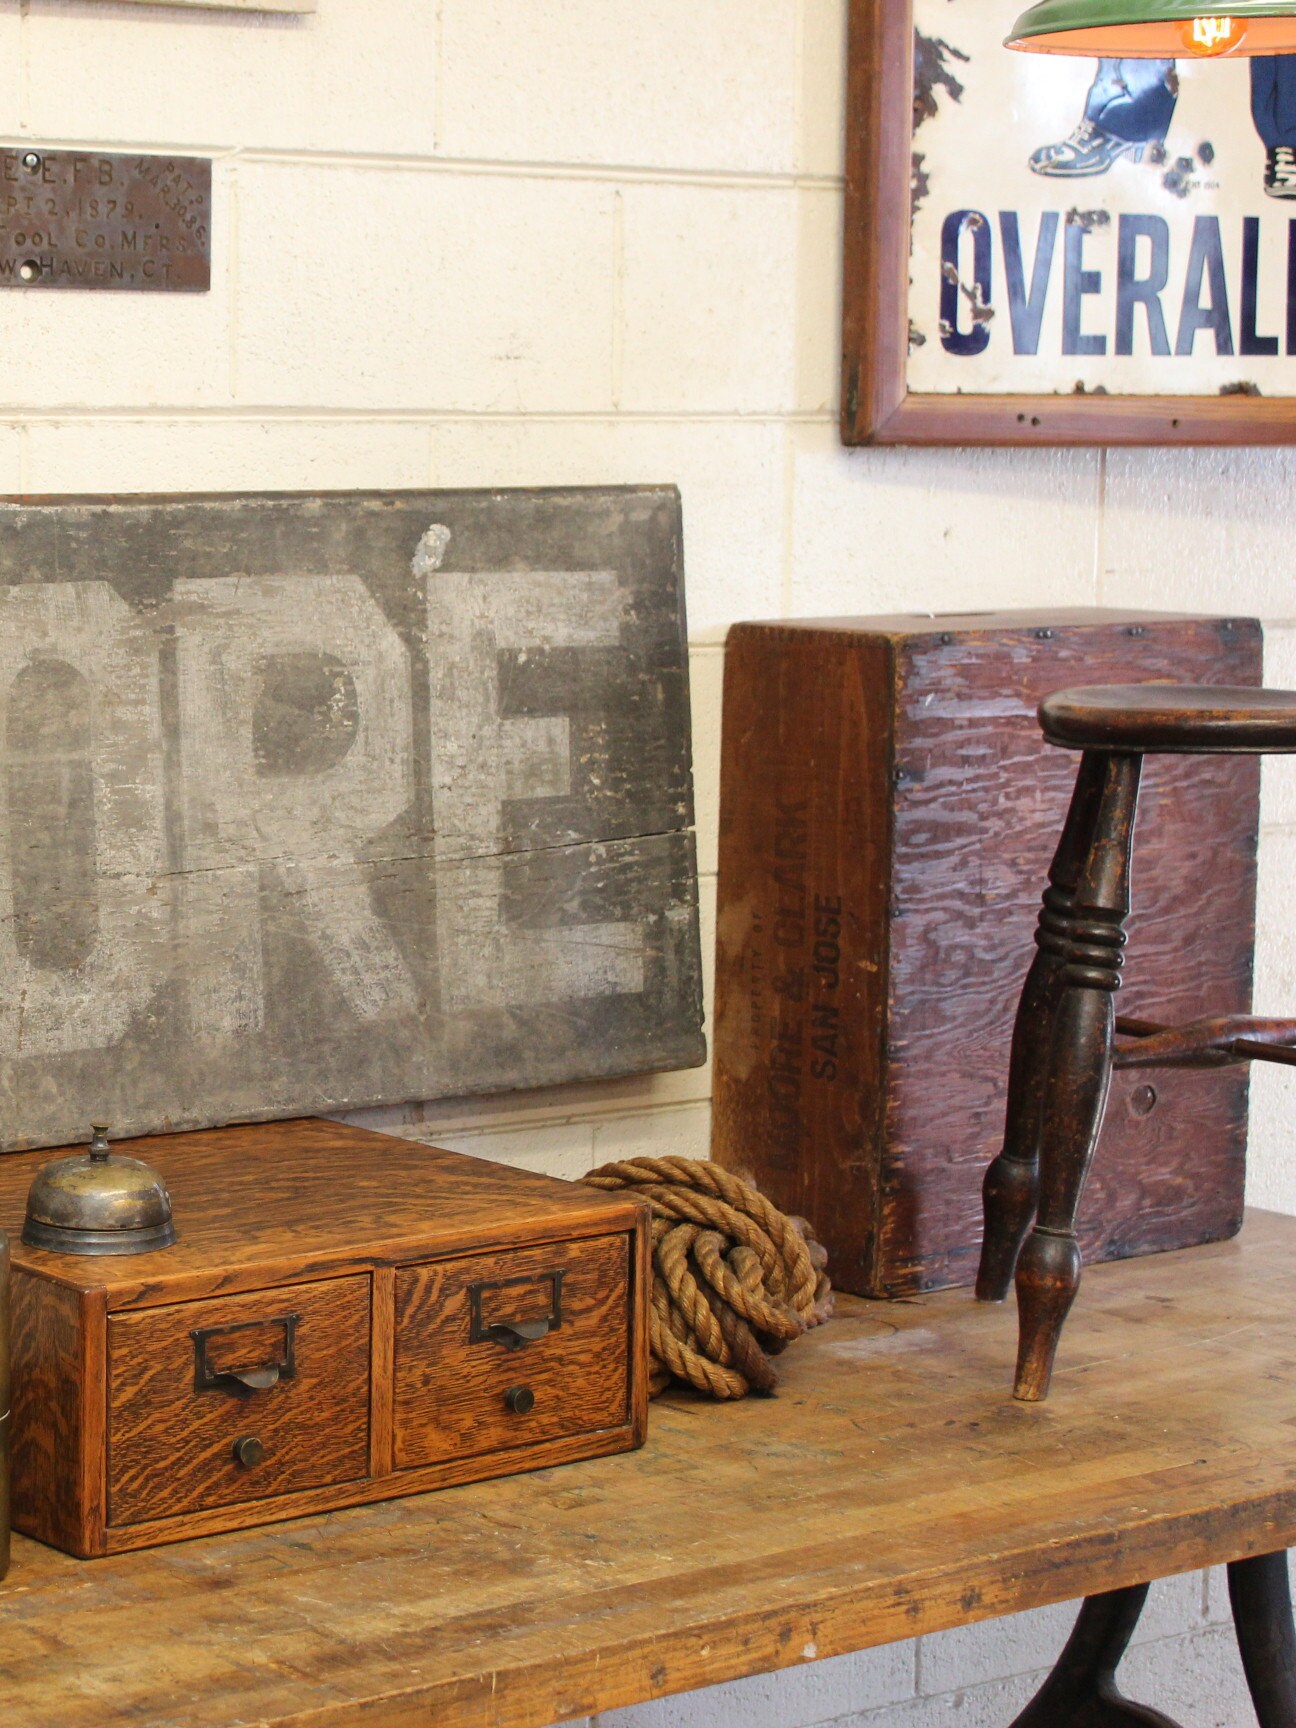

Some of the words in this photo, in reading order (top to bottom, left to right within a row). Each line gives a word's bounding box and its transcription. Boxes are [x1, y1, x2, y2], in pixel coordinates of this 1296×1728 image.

[940, 209, 1296, 357] OVERAL
[811, 893, 841, 992] JOSE
[811, 1002, 840, 1083] SAN
